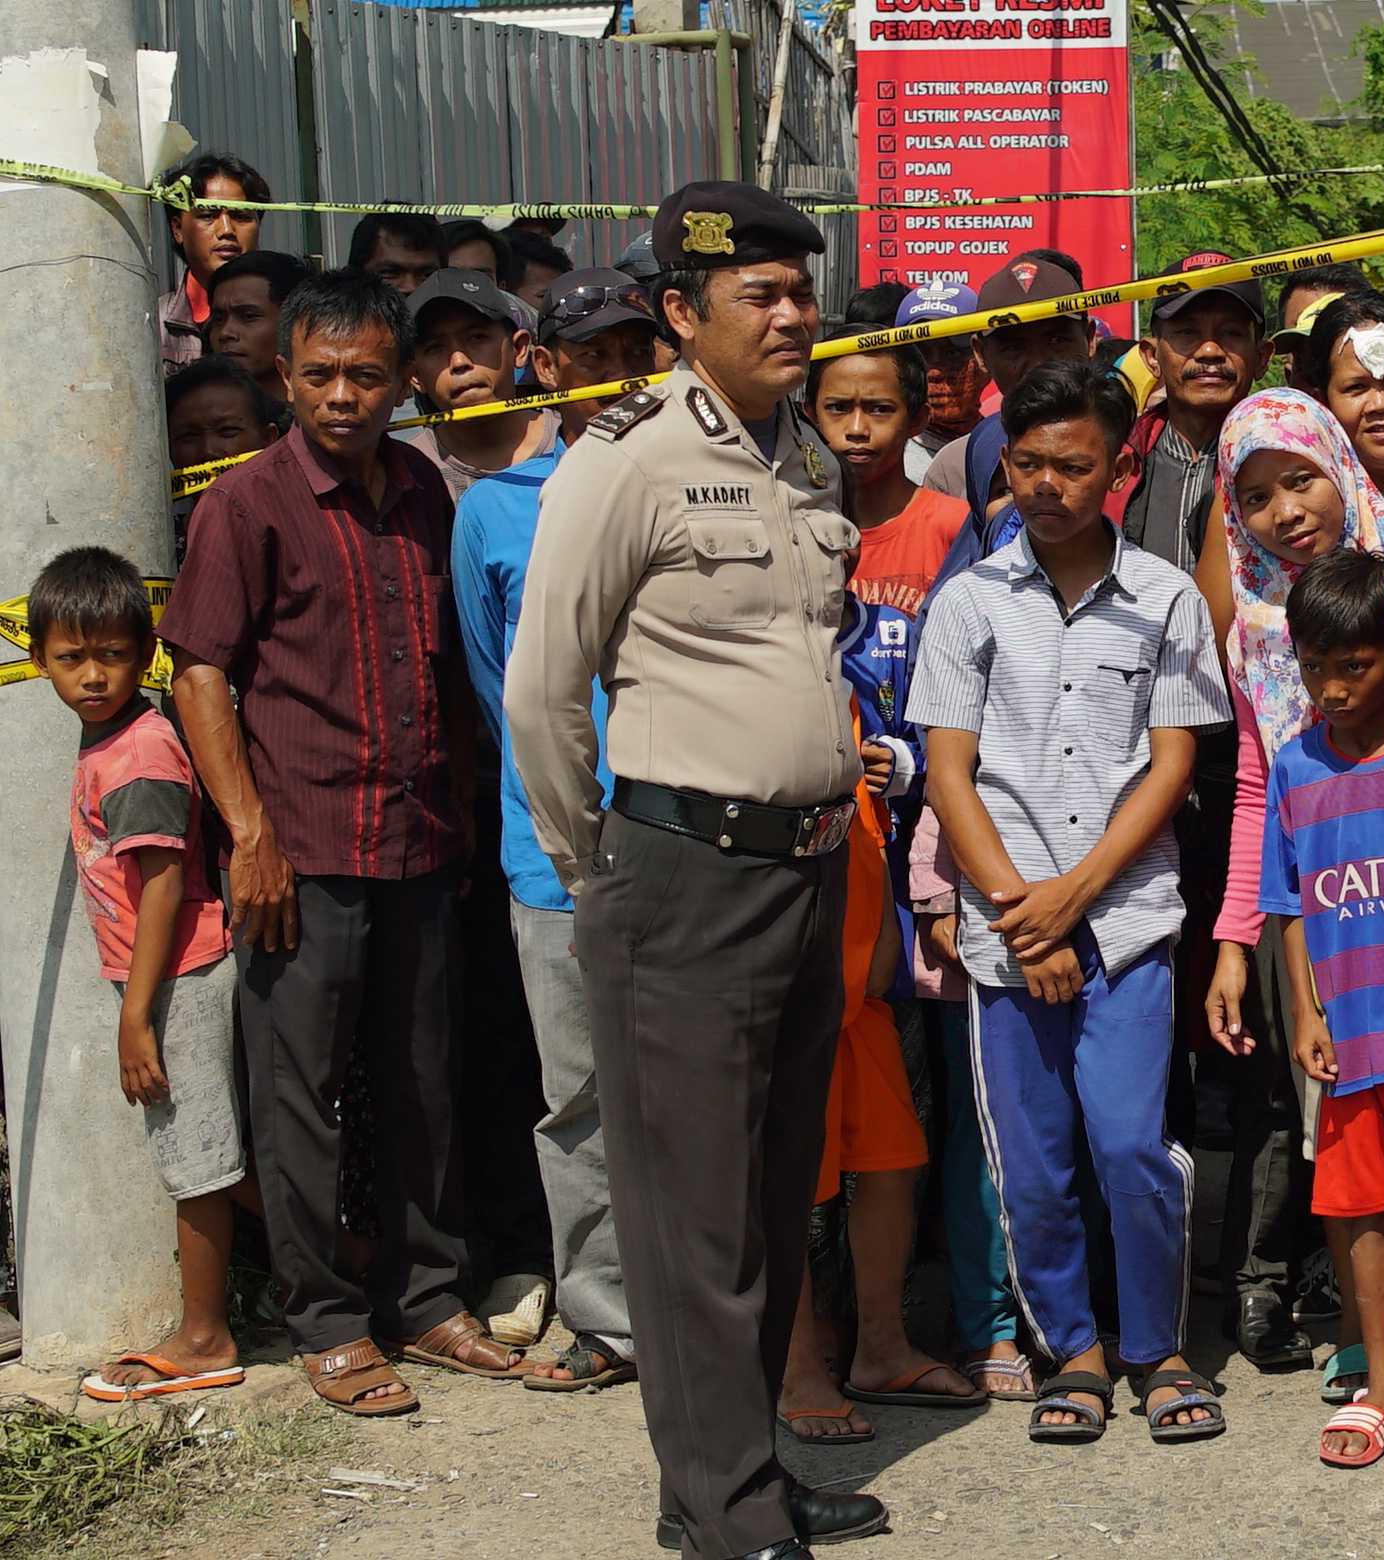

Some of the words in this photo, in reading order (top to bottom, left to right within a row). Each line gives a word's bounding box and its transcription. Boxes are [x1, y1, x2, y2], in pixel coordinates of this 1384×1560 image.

[870, 19, 1022, 40] PEMBAYARAN
[1027, 17, 1111, 39] ONLINE
[904, 81, 961, 96] LISTRIK
[964, 81, 1042, 95] PRABAYAR
[1047, 79, 1109, 95] (TOKEN)
[904, 109, 960, 123] LISTRIK
[963, 108, 1061, 122] PASCABAYAR
[905, 135, 954, 149] PULSA
[957, 135, 985, 148] ALL
[989, 134, 1069, 149] OPERATOR
[904, 162, 951, 176] PDAM
[904, 189, 940, 202] BPJS
[952, 188, 973, 201] TK
[905, 216, 941, 229] BPJS
[944, 216, 1033, 229] KESEHATAN
[904, 241, 956, 254] TOPUP
[960, 241, 1009, 254] GOJEK
[906, 271, 969, 284] TELKOM
[1055, 298, 1079, 313] LINE
[1083, 291, 1120, 308] POLICE
[909, 301, 958, 314] adidas
[894, 328, 914, 342] NOT
[916, 325, 931, 337] DO
[857, 332, 890, 349] CROSS
[685, 486, 751, 505] M.KADAFI
